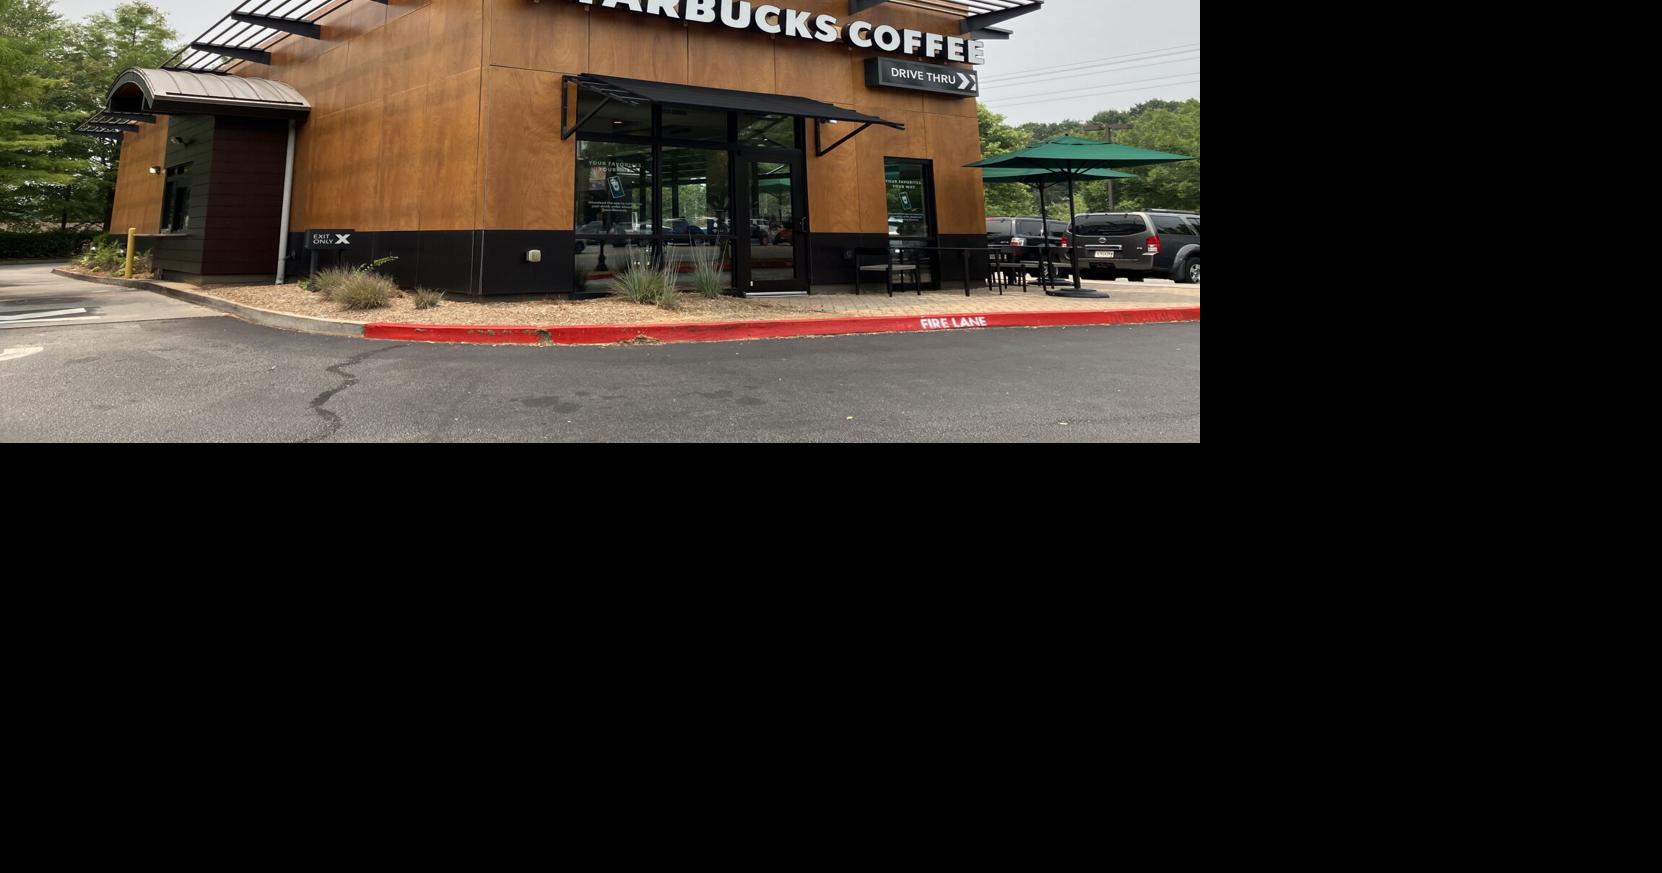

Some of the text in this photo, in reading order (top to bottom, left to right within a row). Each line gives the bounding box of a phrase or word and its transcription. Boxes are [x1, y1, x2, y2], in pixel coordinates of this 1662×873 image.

[579, 0, 985, 65] RBUCKS COFFEE
[891, 67, 956, 85] DRIVE THRU
[920, 316, 988, 330] FIRE LANE
